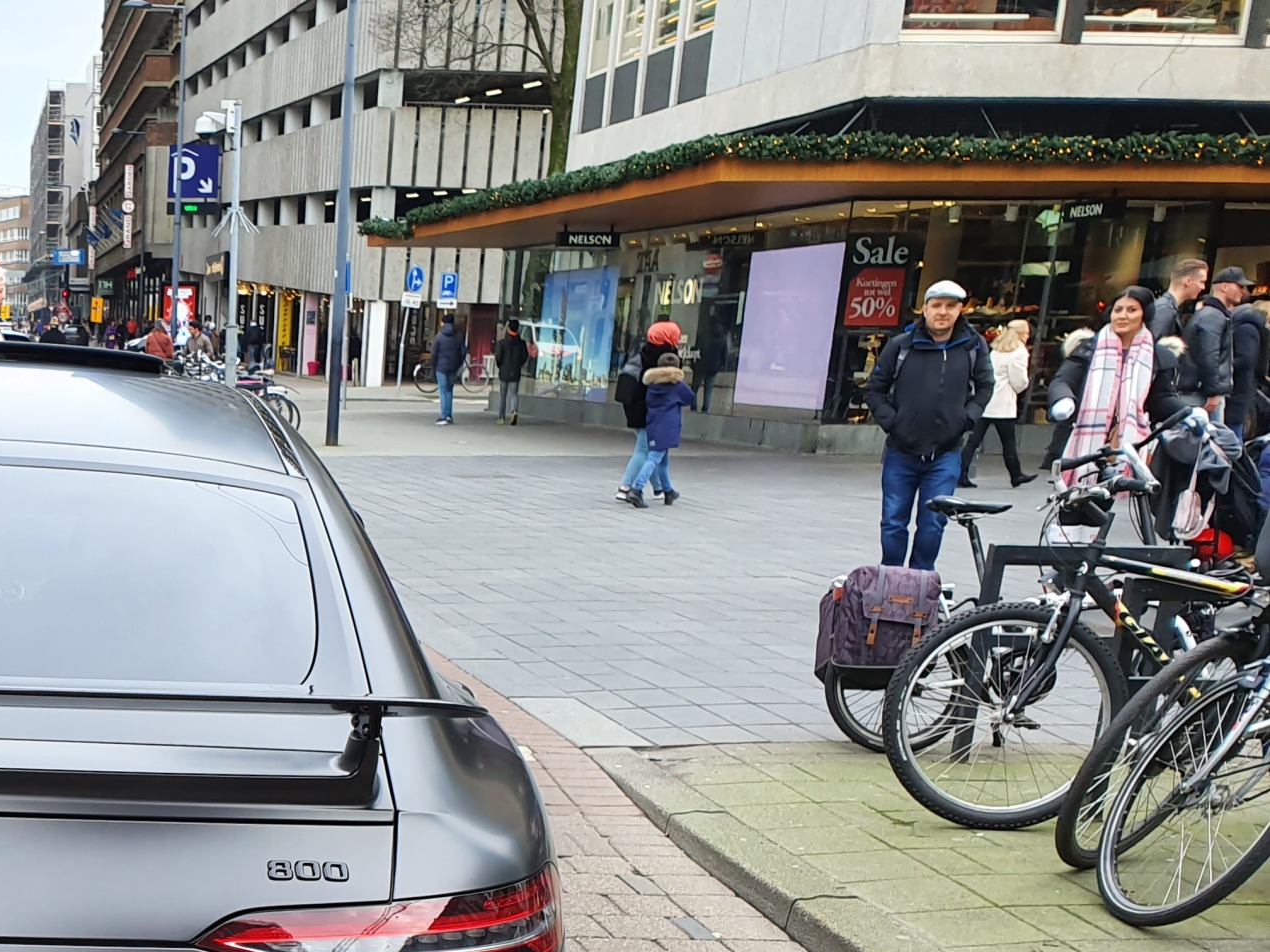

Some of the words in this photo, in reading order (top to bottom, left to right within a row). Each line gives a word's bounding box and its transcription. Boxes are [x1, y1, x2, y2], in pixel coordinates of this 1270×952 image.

[173, 156, 196, 194] P
[1069, 203, 1104, 219] NELSON
[569, 234, 612, 245] NELSON
[852, 236, 909, 265] Sale
[443, 275, 454, 288] P
[653, 279, 703, 305] NELSON
[856, 278, 897, 291] Kortingen
[848, 296, 896, 319] 50%
[267, 859, 350, 882] 800
